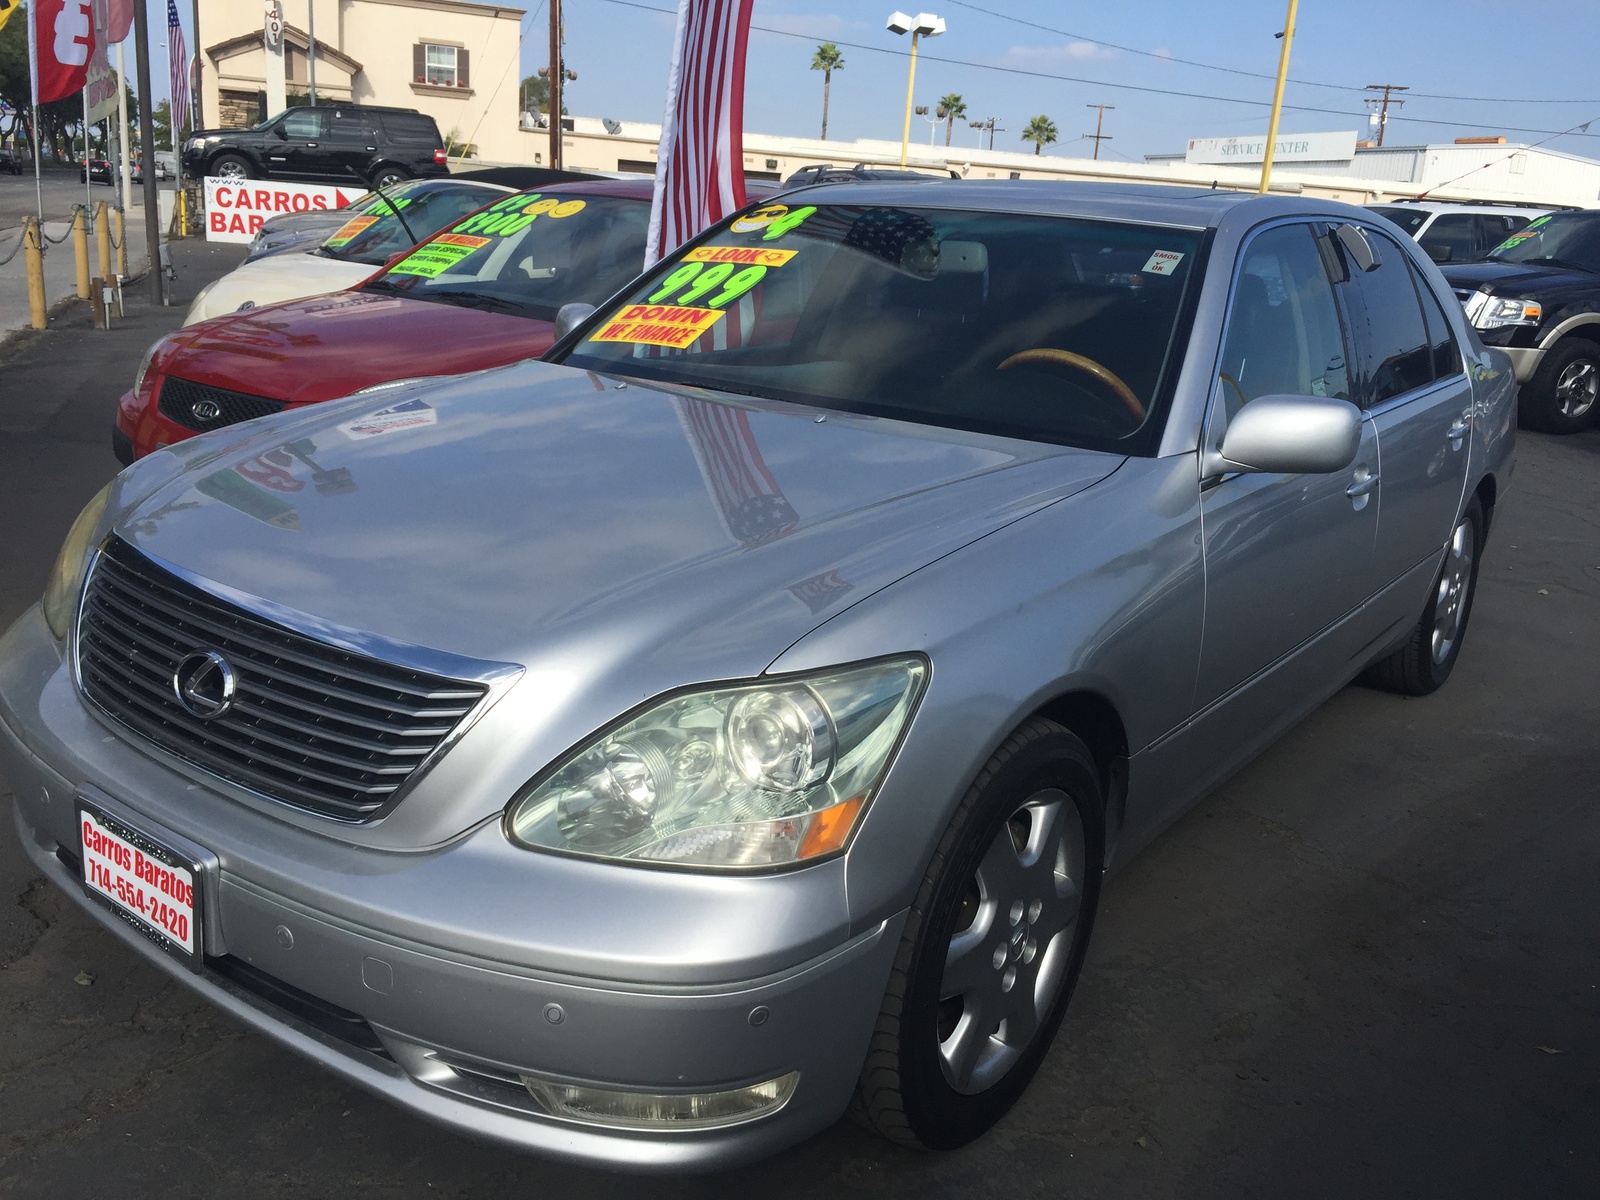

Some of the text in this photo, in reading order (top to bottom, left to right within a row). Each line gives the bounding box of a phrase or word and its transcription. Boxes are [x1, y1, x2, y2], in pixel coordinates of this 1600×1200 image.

[1221, 141, 1310, 156] SERVICE ENTER
[215, 186, 328, 212] CARROS
[452, 212, 538, 237] 8900
[709, 247, 767, 264] LOOK
[1153, 252, 1180, 261] SMOG
[648, 261, 768, 309] 999
[621, 306, 712, 325] DOWN
[599, 323, 698, 345] WE FINANCE
[83, 820, 132, 872] Carros
[134, 848, 194, 909] Baratos
[88, 857, 189, 942] 714-554-2420
